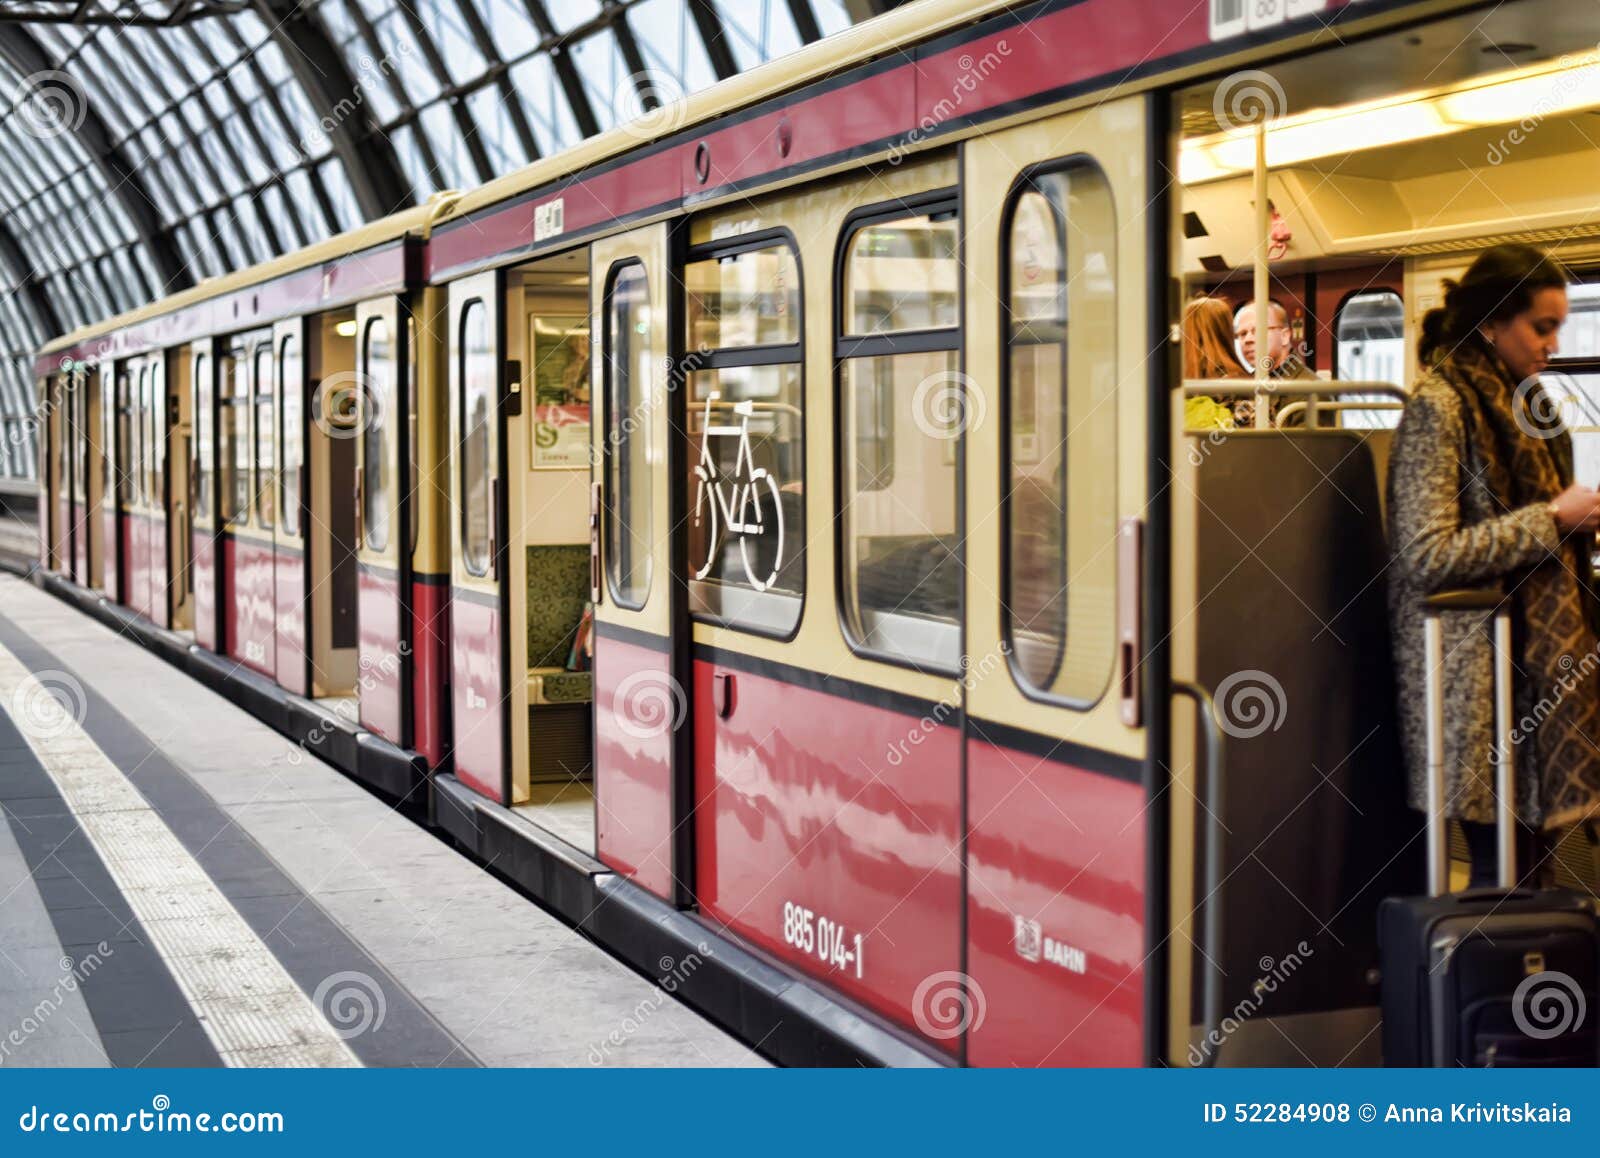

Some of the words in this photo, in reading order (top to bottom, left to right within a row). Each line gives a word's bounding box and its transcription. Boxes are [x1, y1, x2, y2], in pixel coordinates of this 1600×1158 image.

[784, 901, 814, 953] 885
[818, 916, 862, 979] 014-1
[1044, 937, 1086, 974] BAHN
